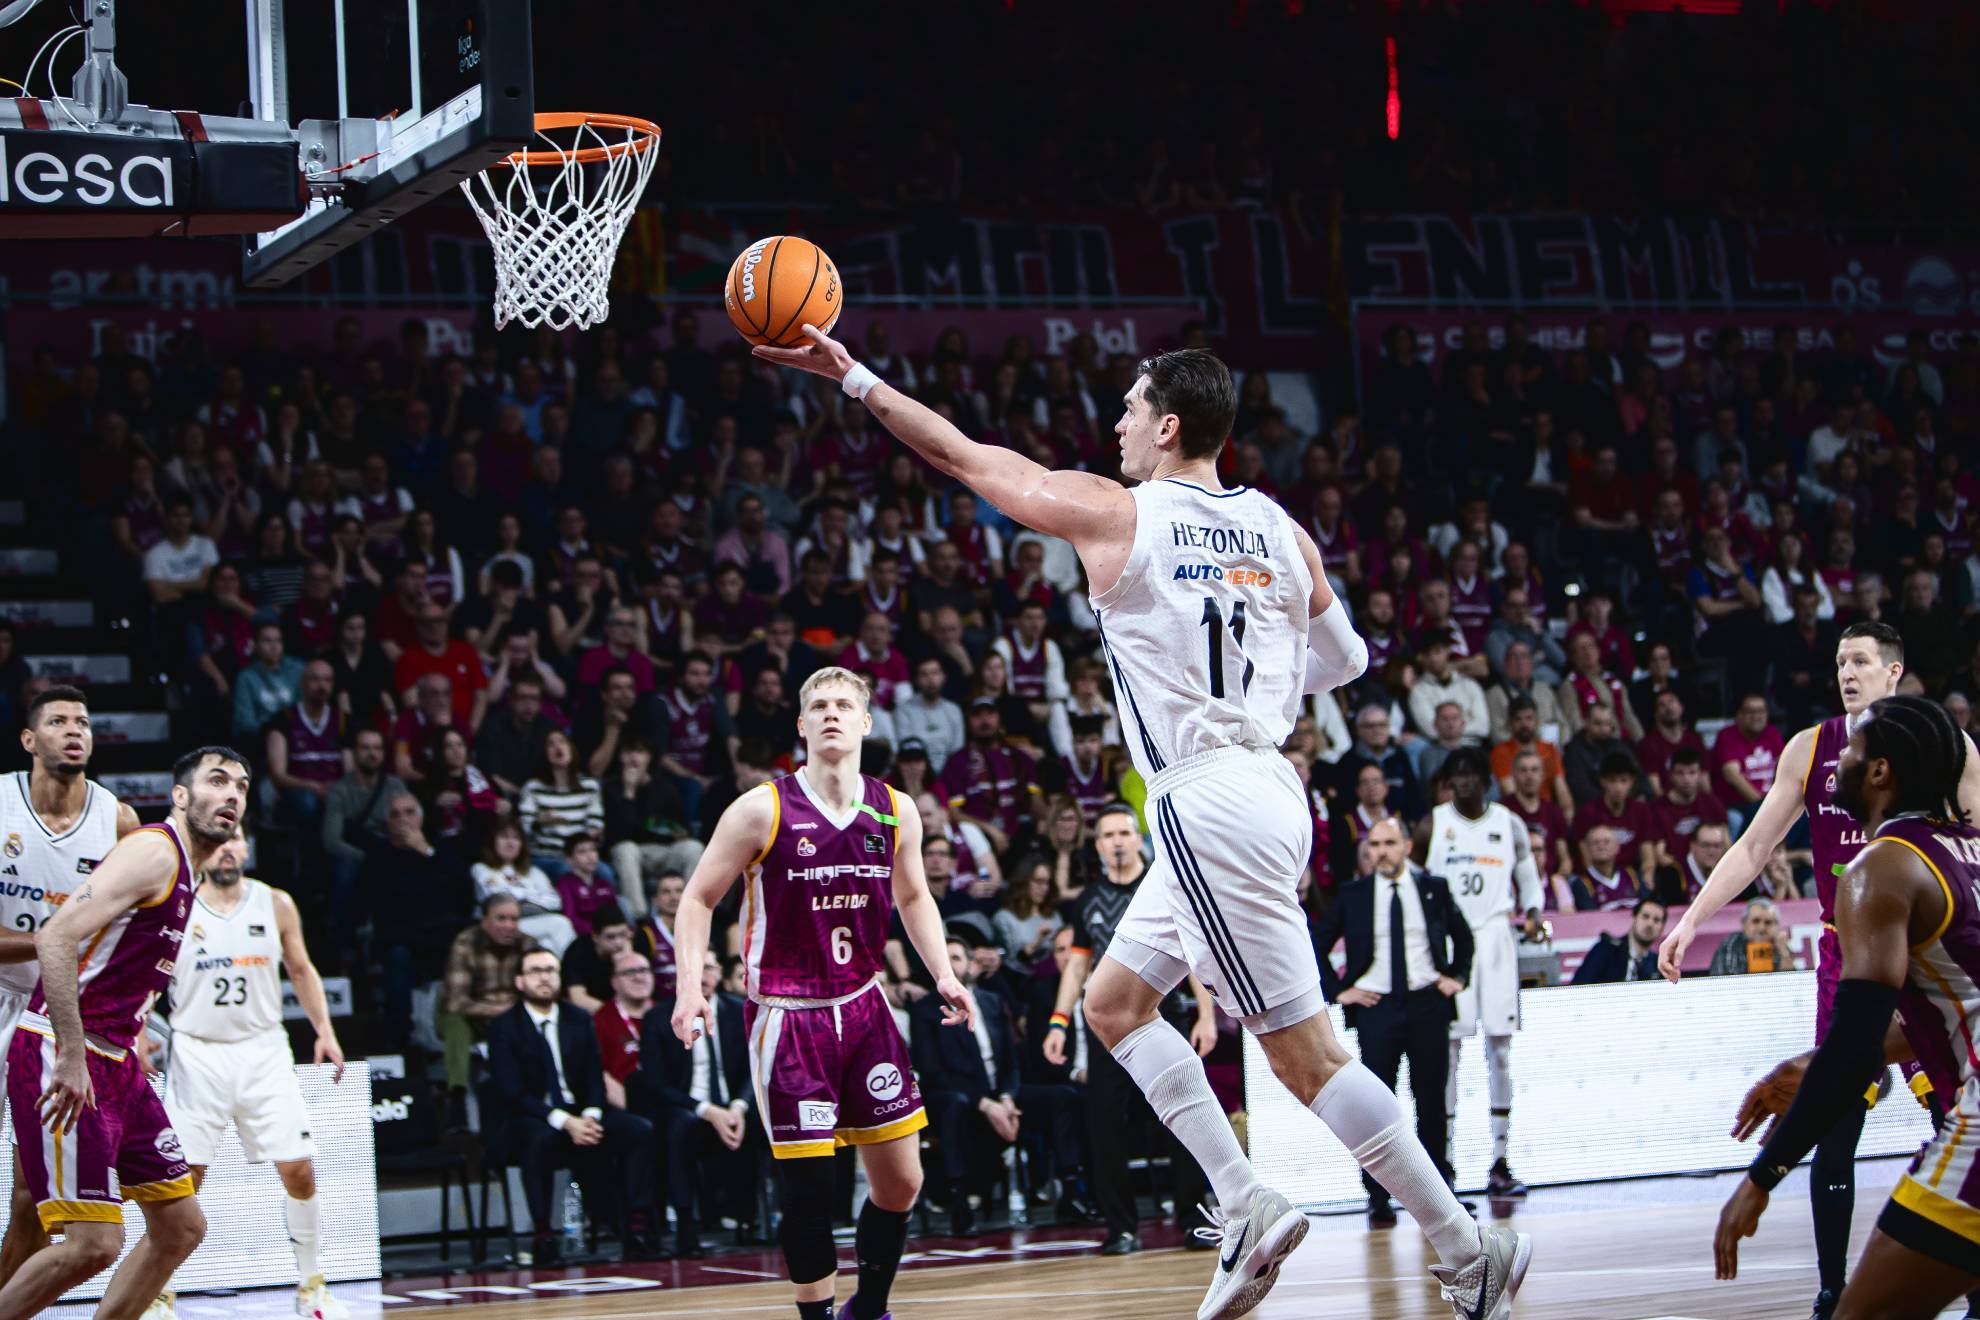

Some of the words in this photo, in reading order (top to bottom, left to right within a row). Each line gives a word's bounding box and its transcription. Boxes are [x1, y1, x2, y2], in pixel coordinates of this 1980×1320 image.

[0, 135, 174, 207] esa
[1171, 521, 1270, 559] HEZONJA
[1172, 564, 1273, 588] AUTOHERO
[1199, 596, 1256, 699] 11
[1840, 830, 1868, 845] LLE
[1459, 872, 1484, 896] 30
[811, 893, 870, 912] LLEIDA
[831, 926, 853, 965] 6
[213, 977, 248, 1007] 23
[869, 1070, 901, 1093] Q2
[873, 1098, 909, 1116] CUDOS
